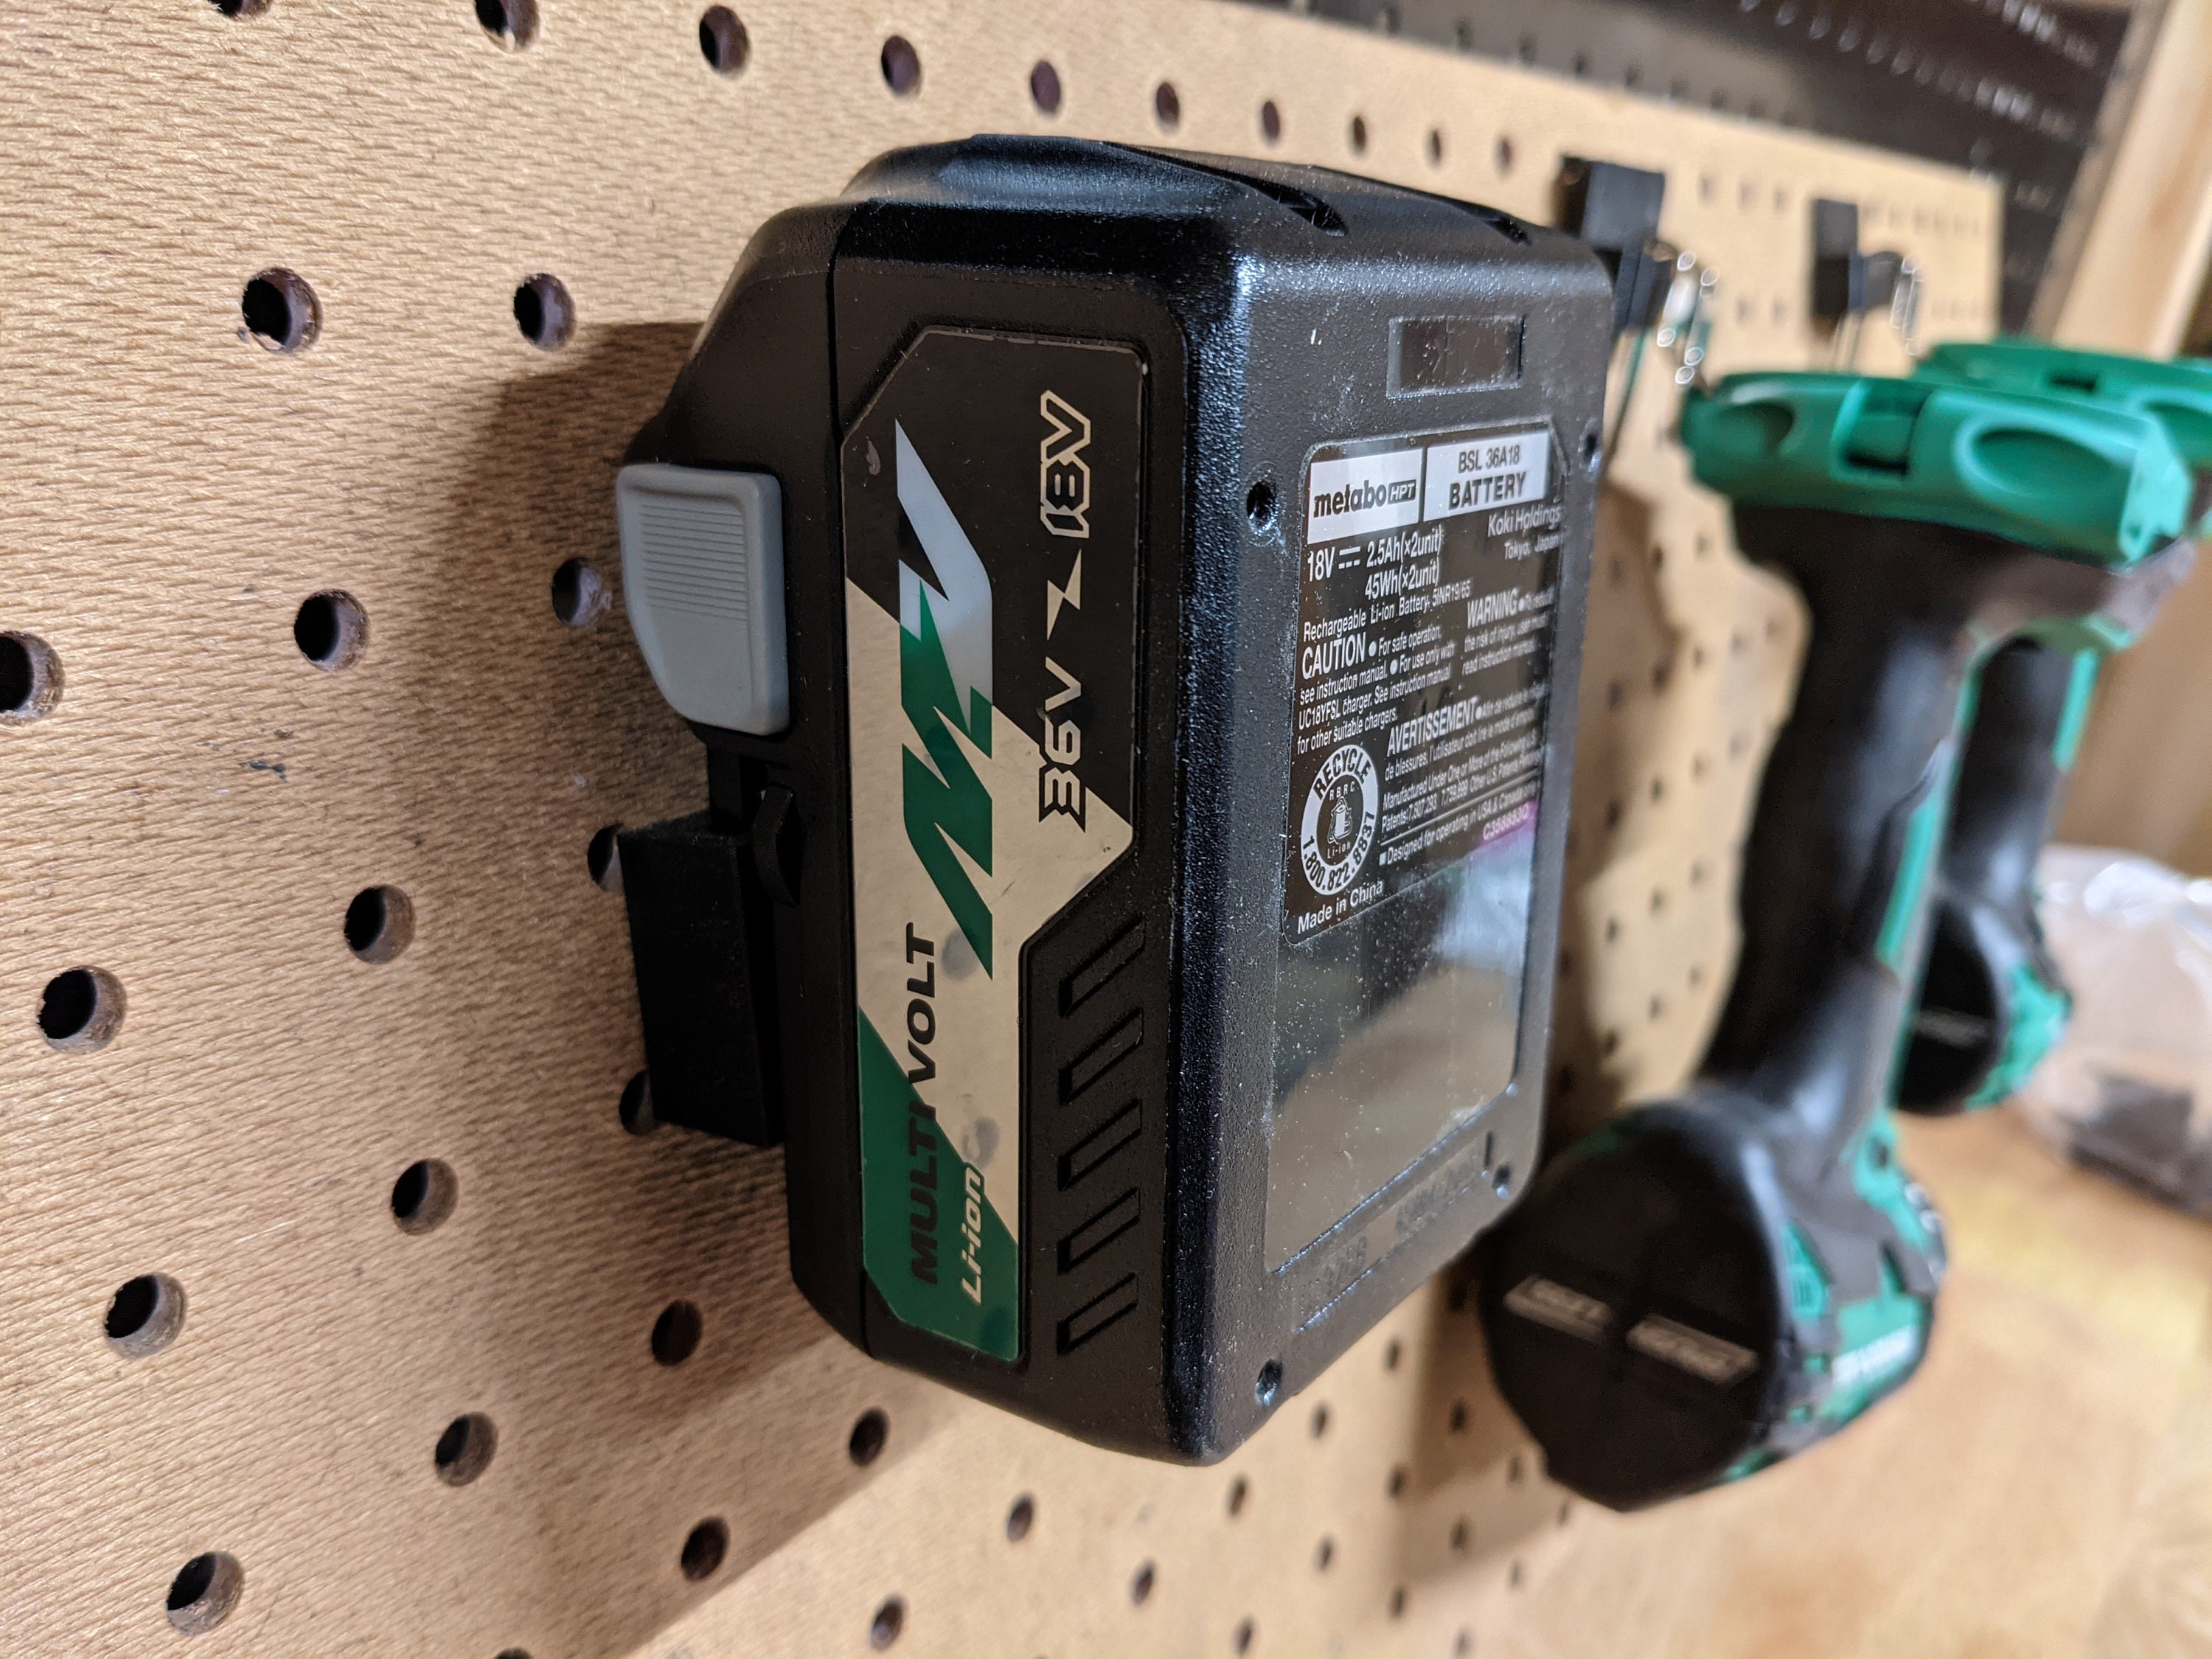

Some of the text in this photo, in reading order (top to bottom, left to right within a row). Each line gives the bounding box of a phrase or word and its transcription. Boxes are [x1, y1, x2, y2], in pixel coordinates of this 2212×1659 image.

[1458, 445, 1520, 474] BSL 36A18
[1313, 480, 1416, 518] metabo HPT
[1448, 472, 1526, 510] BATTERY
[1488, 504, 1562, 538] Koki Holdings
[1307, 547, 1335, 582] 18V
[1040, 389, 1091, 817] 36V 18V
[1304, 608, 1366, 642] Rechargeable
[1370, 604, 1394, 625] Li-ion
[1467, 587, 1520, 629] WARNING
[1300, 641, 1455, 706] see instruction manual. For use only with
[1302, 632, 1366, 680] CAUTION
[1377, 637, 1389, 657] For
[1391, 631, 1406, 653] safe
[1462, 655, 1478, 675] read
[1298, 664, 1451, 730] UC18YFSL charger. See instruction manual
[1297, 706, 1398, 755] for other suitable chargers.
[1387, 695, 1479, 757] AVERTISSEMENT
[1313, 748, 1371, 801] RECYCLE
[1329, 781, 1355, 801] RBRC
[1382, 782, 1428, 811] Manufactured
[1428, 771, 1447, 791] Under
[1447, 765, 1459, 783] One
[1461, 763, 1468, 776] or
[1385, 763, 1394, 782] de
[1303, 810, 1374, 891] 1.800.822.8837
[1327, 841, 1351, 860] Li-ion
[1387, 834, 1423, 865] Designed
[1424, 830, 1436, 846] for
[1436, 810, 1469, 843] operating
[1470, 808, 1476, 824] in
[1298, 880, 1384, 935] Made in China
[906, 922, 936, 1084] VOLT
[961, 1166, 981, 1304] Li-ion
